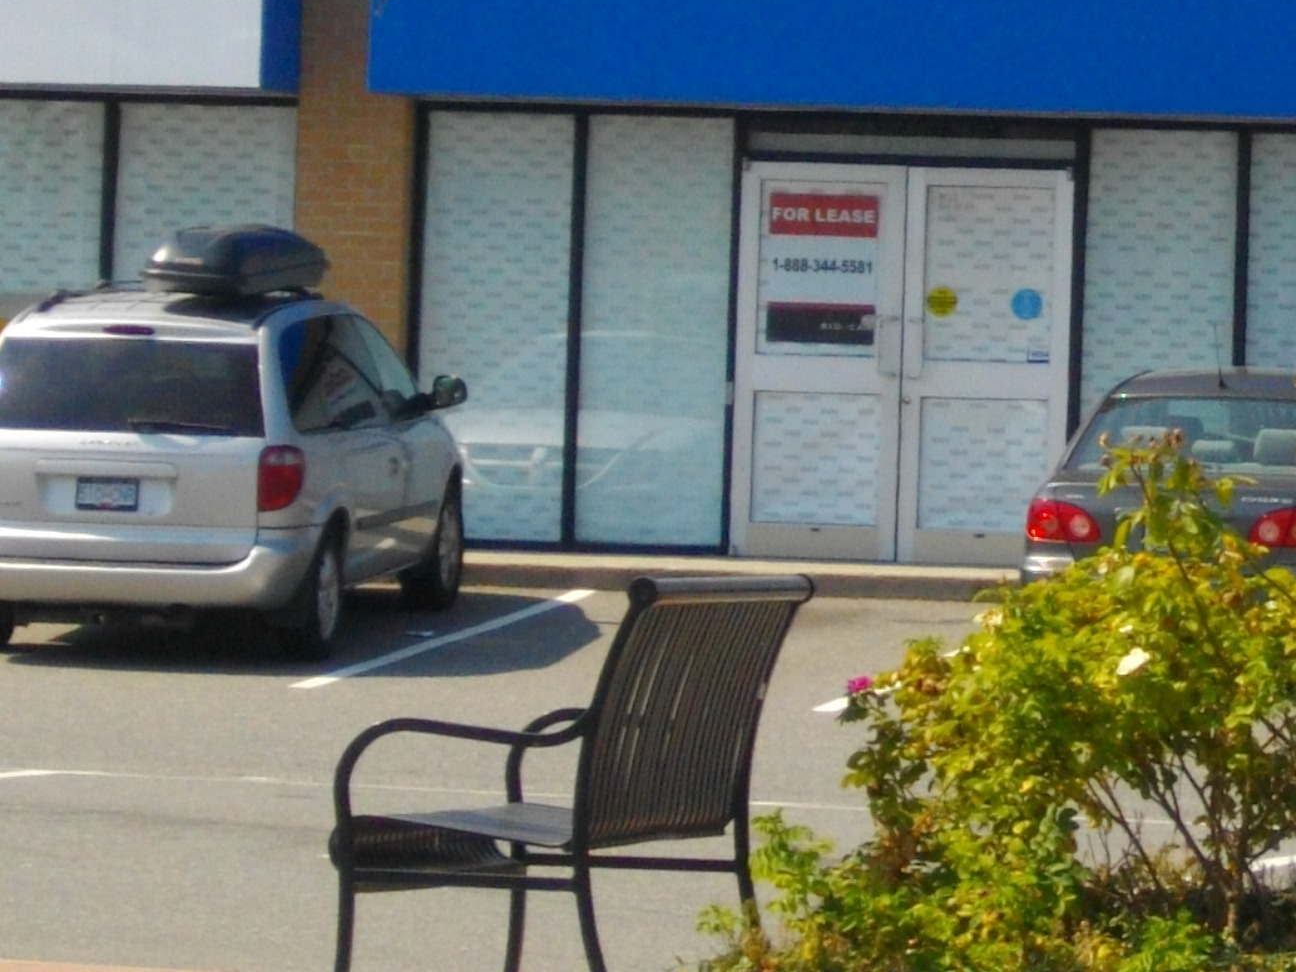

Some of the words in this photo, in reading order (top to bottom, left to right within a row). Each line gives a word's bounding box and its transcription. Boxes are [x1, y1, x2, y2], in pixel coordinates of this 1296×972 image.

[773, 207, 809, 222] FOR
[815, 209, 875, 224] LEASE
[772, 257, 872, 274] 1-888-344-5581
